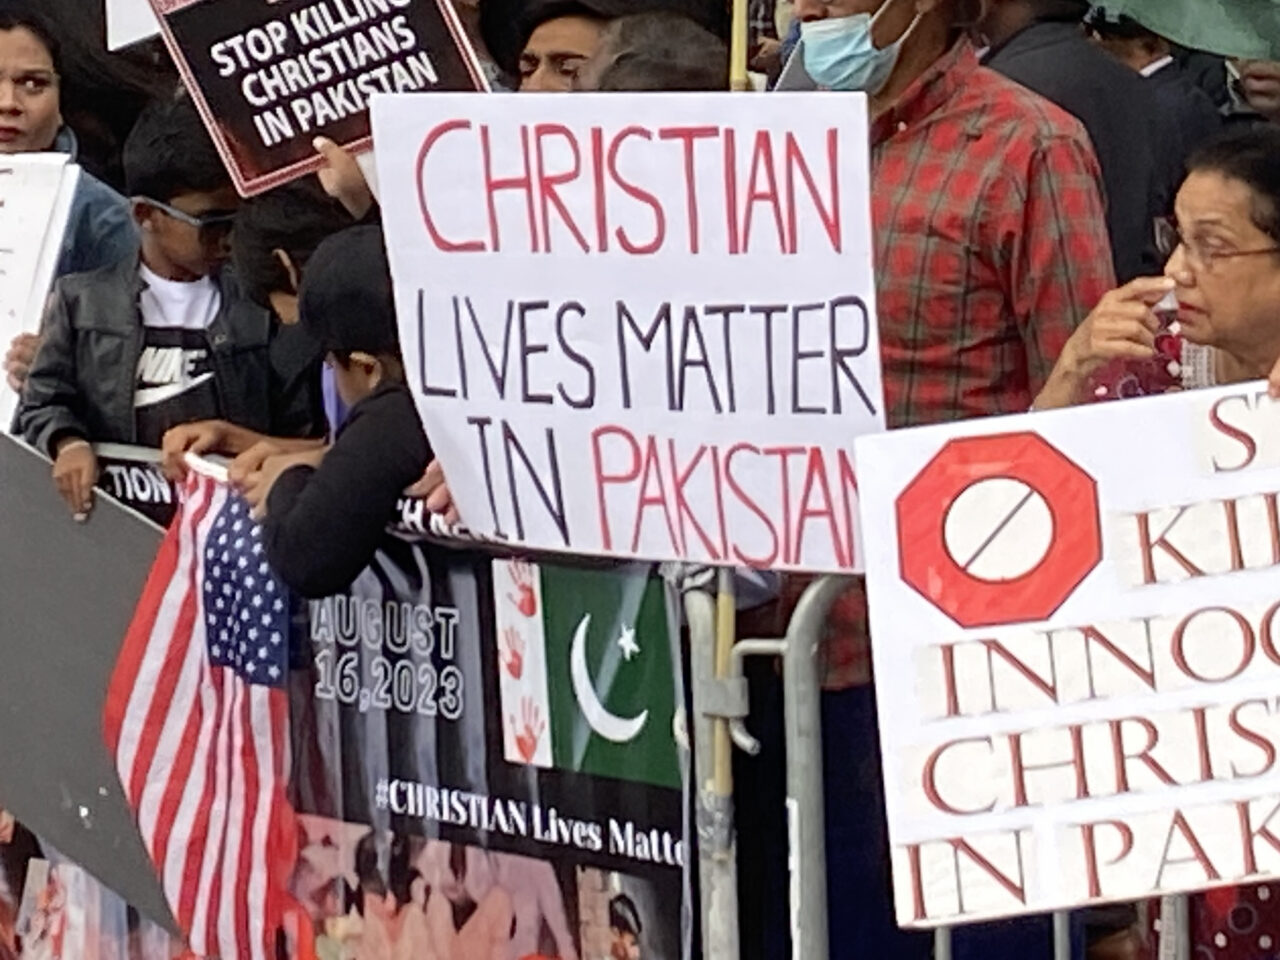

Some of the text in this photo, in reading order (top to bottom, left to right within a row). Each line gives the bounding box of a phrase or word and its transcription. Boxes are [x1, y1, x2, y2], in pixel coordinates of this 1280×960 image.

[210, 20, 288, 78] STOP
[242, 15, 416, 107] CHRISTIANS
[253, 50, 439, 148] IN PAKISTAN
[416, 119, 842, 255] CHRISTIAN
[417, 288, 877, 416] LIVES MATTER
[466, 415, 859, 570] IN PAKISTAN
[310, 595, 460, 661] AUGUST
[375, 778, 529, 837] #CHRISTIAN
[532, 802, 602, 852] Lives
[902, 828, 1028, 923] IN
